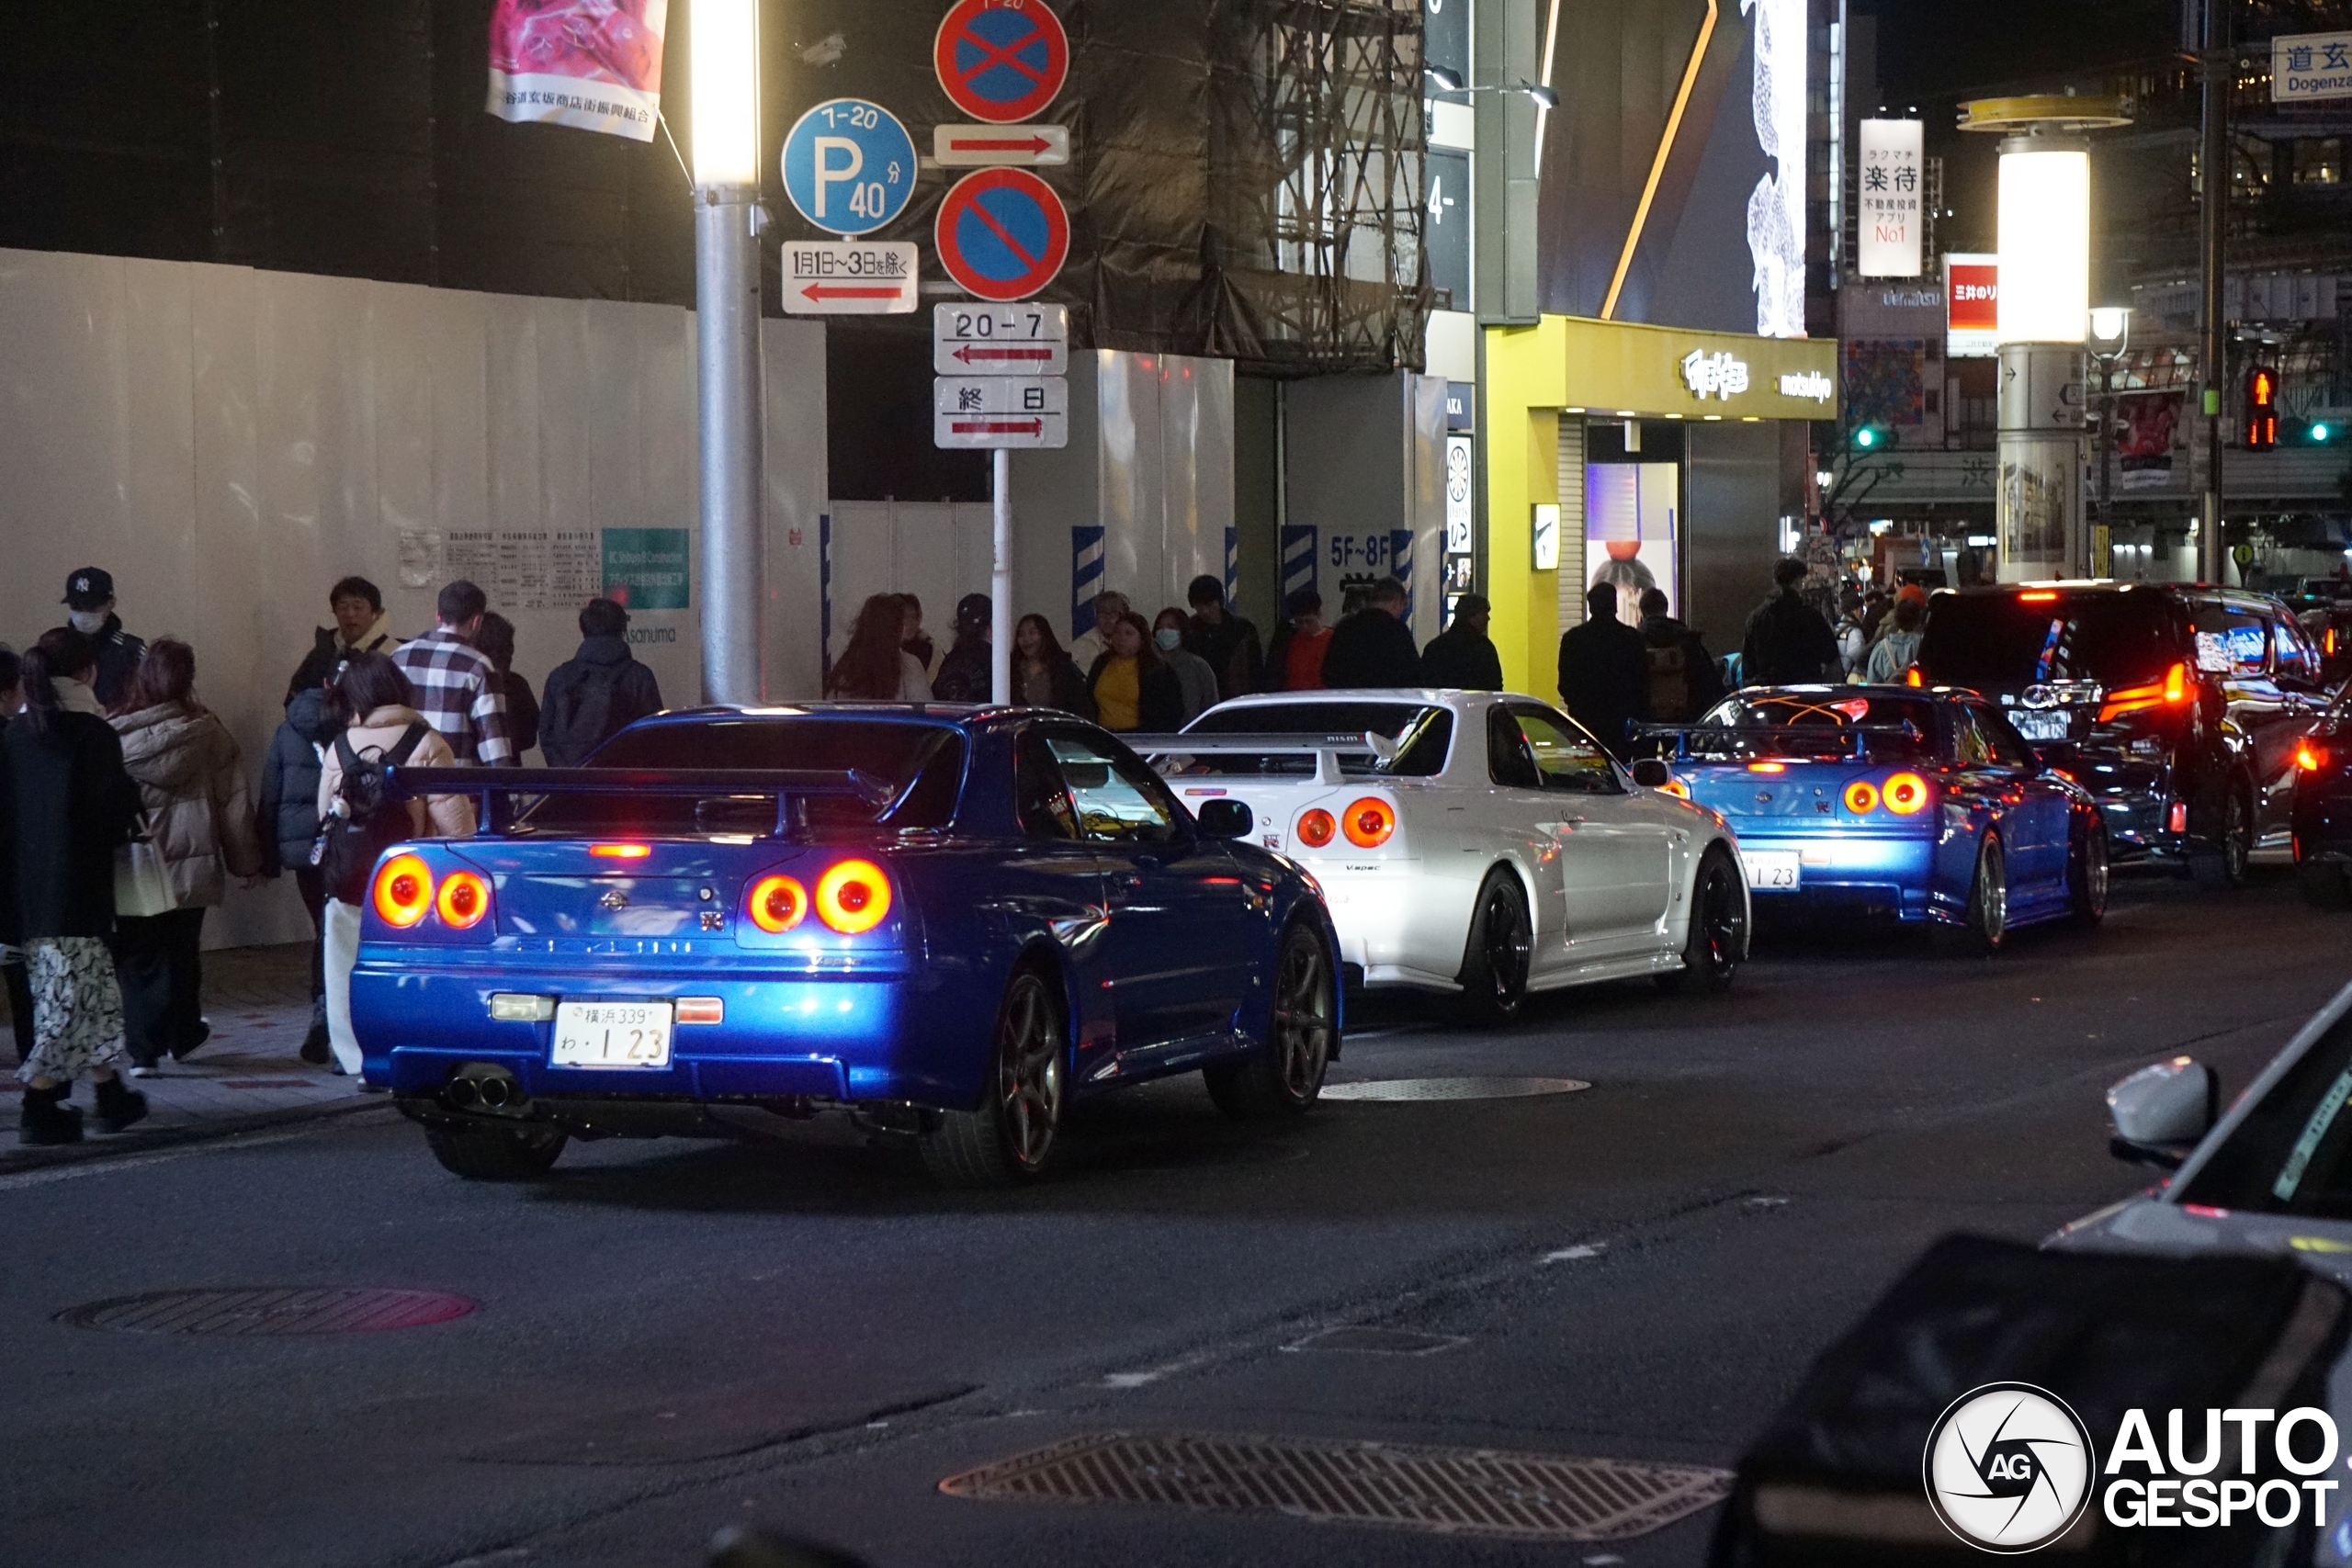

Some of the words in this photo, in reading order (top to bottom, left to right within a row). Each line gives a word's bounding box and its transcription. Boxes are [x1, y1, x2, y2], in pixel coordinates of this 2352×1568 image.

[2287, 42, 2349, 72] 道玄
[502, 90, 650, 123] 谷道玄坂商店街振興組合
[1869, 150, 1913, 161] ラクマチ
[815, 137, 863, 218] P
[888, 162, 900, 184] 分
[1864, 165, 1917, 193] 楽待
[849, 182, 885, 218] 40
[1864, 198, 1917, 210] 不動産投資
[1876, 212, 1905, 223] アプリ
[1954, 285, 1997, 301] 三井のリ
[1781, 370, 1832, 404] matsukiyo
[1451, 522, 1467, 548] UP
